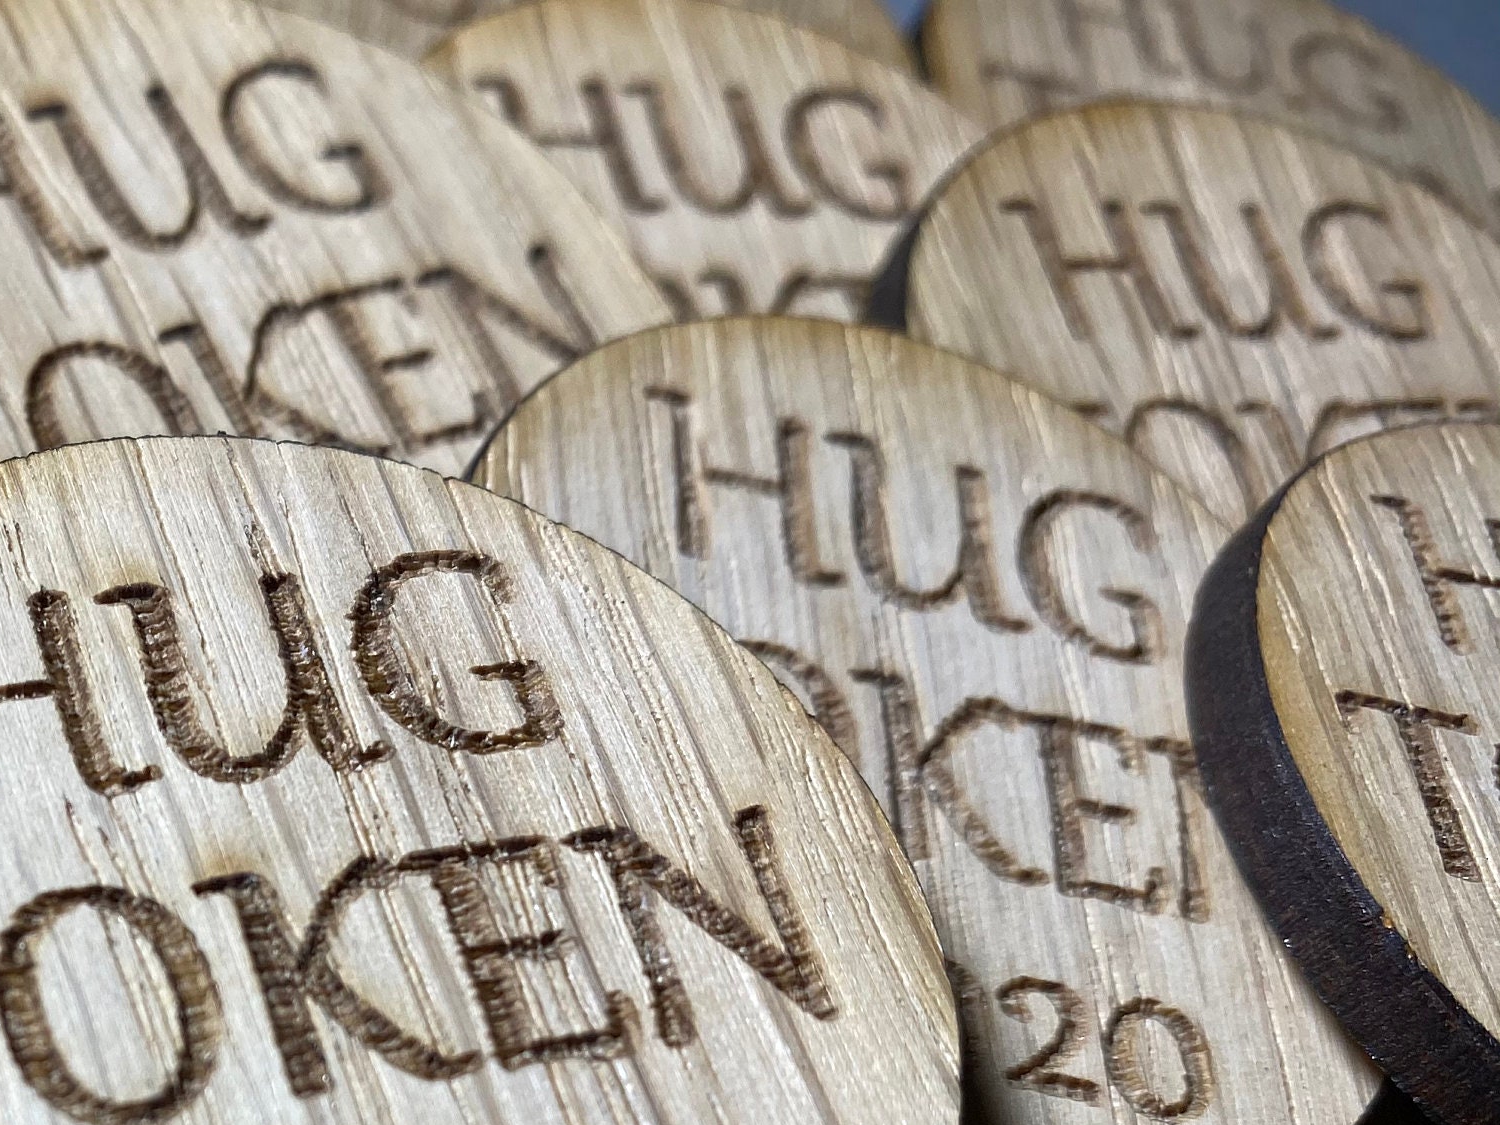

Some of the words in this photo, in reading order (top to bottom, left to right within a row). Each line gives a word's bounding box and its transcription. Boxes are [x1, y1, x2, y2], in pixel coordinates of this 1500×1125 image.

[473, 76, 909, 222] HUG
[1000, 198, 1432, 342] HUG
[643, 386, 1168, 664] HUG
